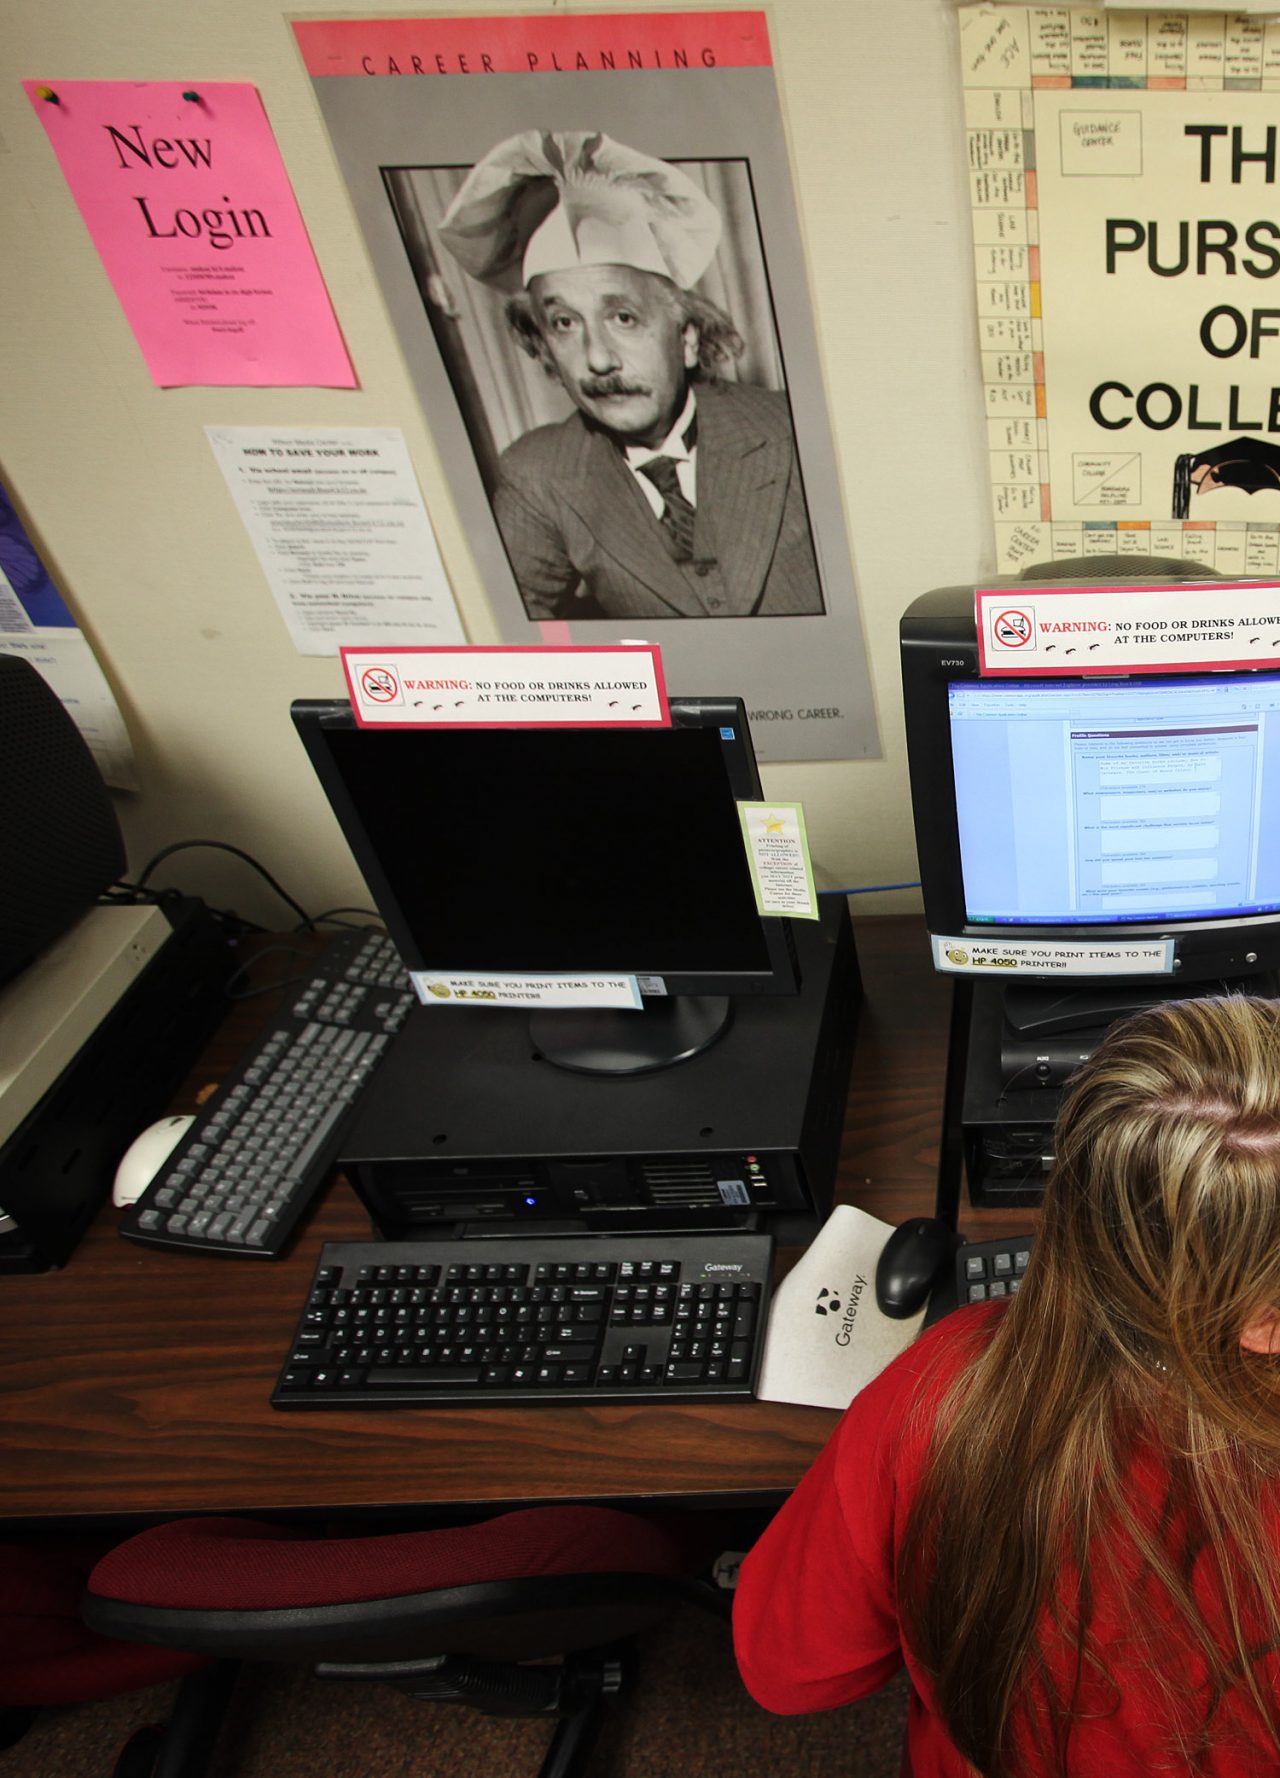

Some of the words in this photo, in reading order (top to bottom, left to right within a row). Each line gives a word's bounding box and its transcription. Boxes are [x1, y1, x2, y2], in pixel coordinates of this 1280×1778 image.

[361, 53, 495, 77] CAREER
[528, 48, 716, 73] PLANNING
[103, 125, 213, 170] New
[132, 195, 272, 250] Login
[269, 449, 283, 457] TO
[1039, 620, 1113, 634] WARNING:
[1115, 622, 1132, 632] NO
[1135, 621, 1168, 631] FOOD
[1171, 620, 1189, 630] OR
[1191, 618, 1236, 629] DRINKS
[1114, 635, 1130, 645] AT
[1132, 634, 1158, 644] THE
[1160, 631, 1234, 643] COMPUTERS!
[940, 659, 965, 667] EV730
[403, 679, 474, 690] WARNING:
[475, 681, 492, 690] NO
[494, 681, 526, 690] FOOD
[529, 681, 545, 690] OR
[548, 681, 591, 690] DRINKS
[593, 681, 648, 690] ALLOWED
[477, 693, 492, 702] AT
[494, 693, 518, 702] THE
[520, 693, 593, 702] COMPUTERS!
[748, 708, 793, 722] WRONG
[797, 707, 845, 721] CAREER.
[971, 947, 999, 956] MAKE
[1002, 948, 1028, 957] SURE
[1030, 949, 1052, 958] YOU
[1054, 951, 1084, 959] PRINT
[1089, 951, 1121, 959] ITEMS
[1142, 950, 1162, 958] THE
[972, 957, 987, 965] HP
[990, 958, 1018, 967] 4050
[450, 980, 475, 988] MAKE
[478, 980, 501, 988] SURE
[503, 981, 523, 989] YOU
[525, 982, 553, 990] PRINT
[454, 989, 468, 998] HP
[471, 990, 497, 999] 4050
[704, 1263, 744, 1273] Gateway
[834, 1274, 868, 1348] Gateway
